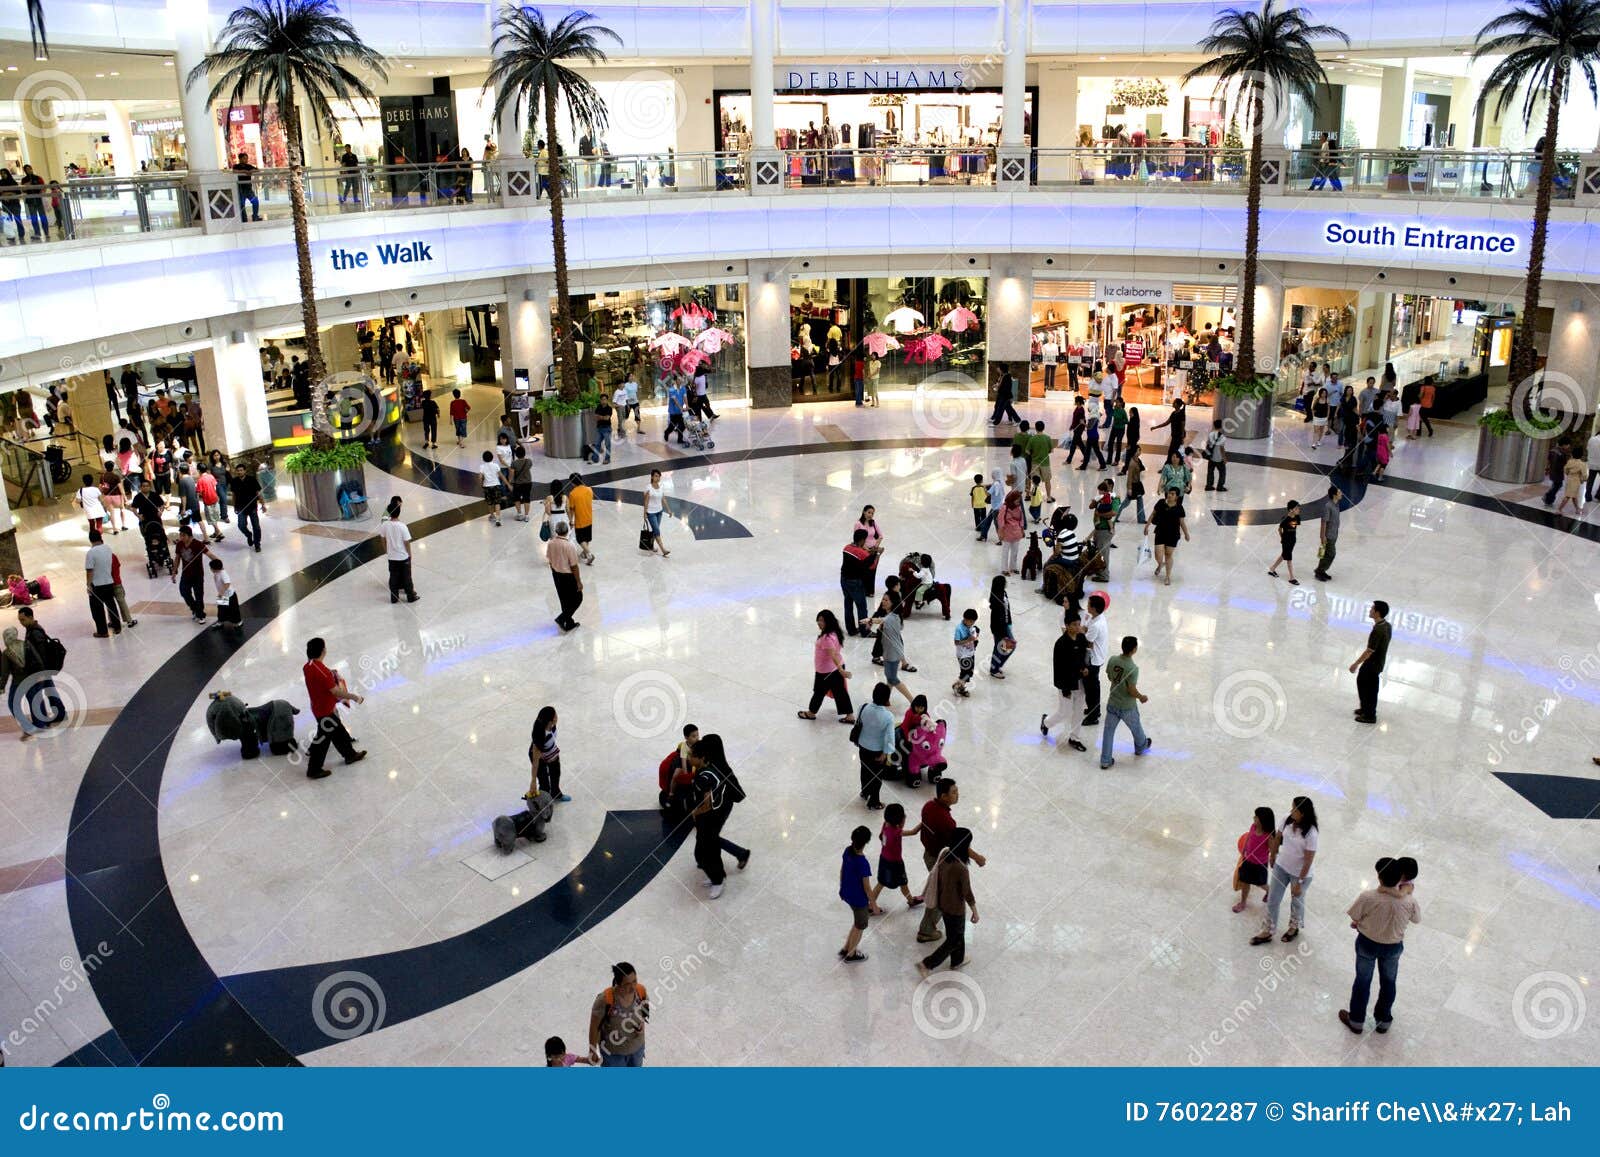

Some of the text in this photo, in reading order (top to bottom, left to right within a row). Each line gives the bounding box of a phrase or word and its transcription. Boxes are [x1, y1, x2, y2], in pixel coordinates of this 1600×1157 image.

[788, 71, 963, 89] DEBENHAMS
[1326, 223, 1516, 253] South Entrance
[331, 241, 433, 271] the Walk
[1116, 285, 1162, 297] claiborne
